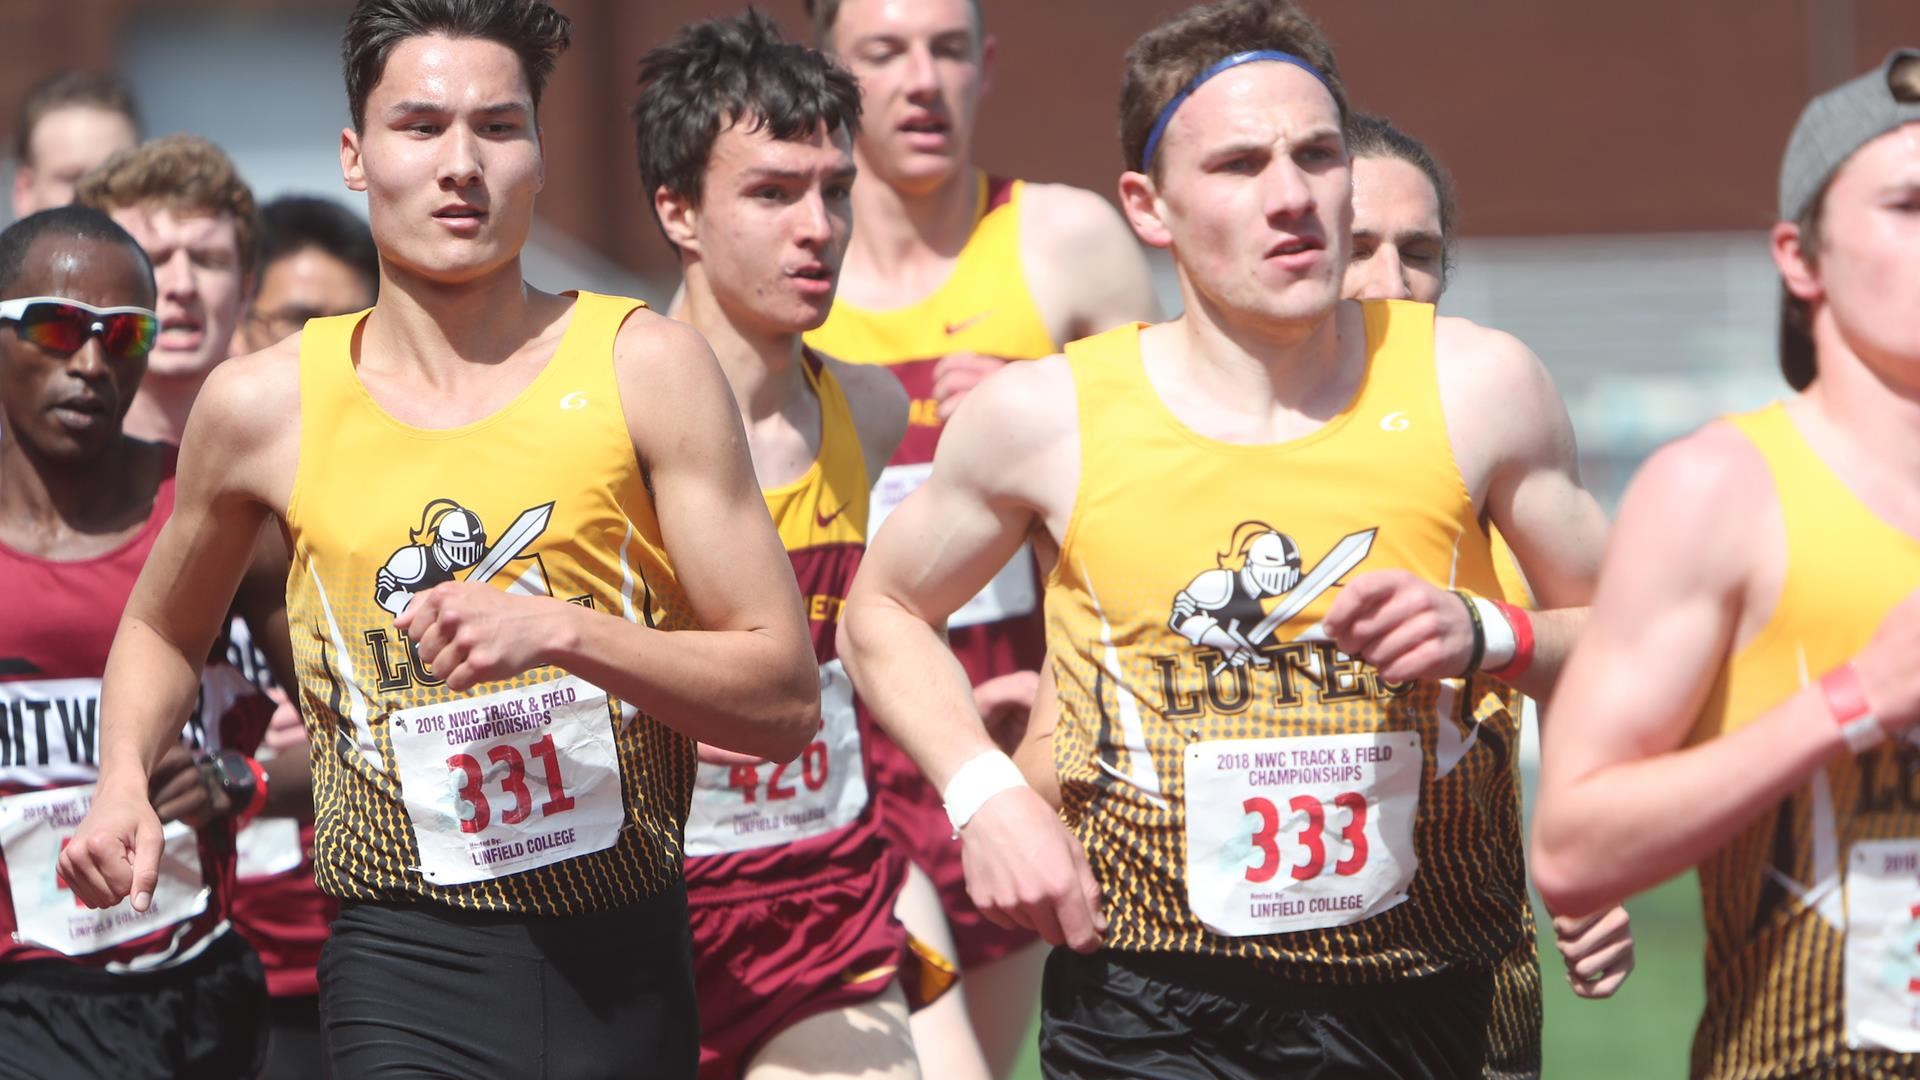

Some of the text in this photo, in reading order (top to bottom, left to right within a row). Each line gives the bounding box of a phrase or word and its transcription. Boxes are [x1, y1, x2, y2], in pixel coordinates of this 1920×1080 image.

[1153, 639, 1414, 720] LUTE
[416, 687, 577, 735] 2018 NWC TRACK & FIELD
[447, 710, 552, 745] CHAMPIONSHIPS
[1217, 746, 1393, 770] 2018 NWC TRACK & FIELD
[1249, 765, 1363, 787] CHAMPIONSHIPS
[446, 733, 576, 834] 331
[472, 842, 525, 866] LINFIELD
[527, 828, 577, 854] COLLEGE
[1243, 791, 1369, 883] 333
[1250, 900, 1305, 918] LINFIELD
[1309, 894, 1363, 913] COLLEGE
